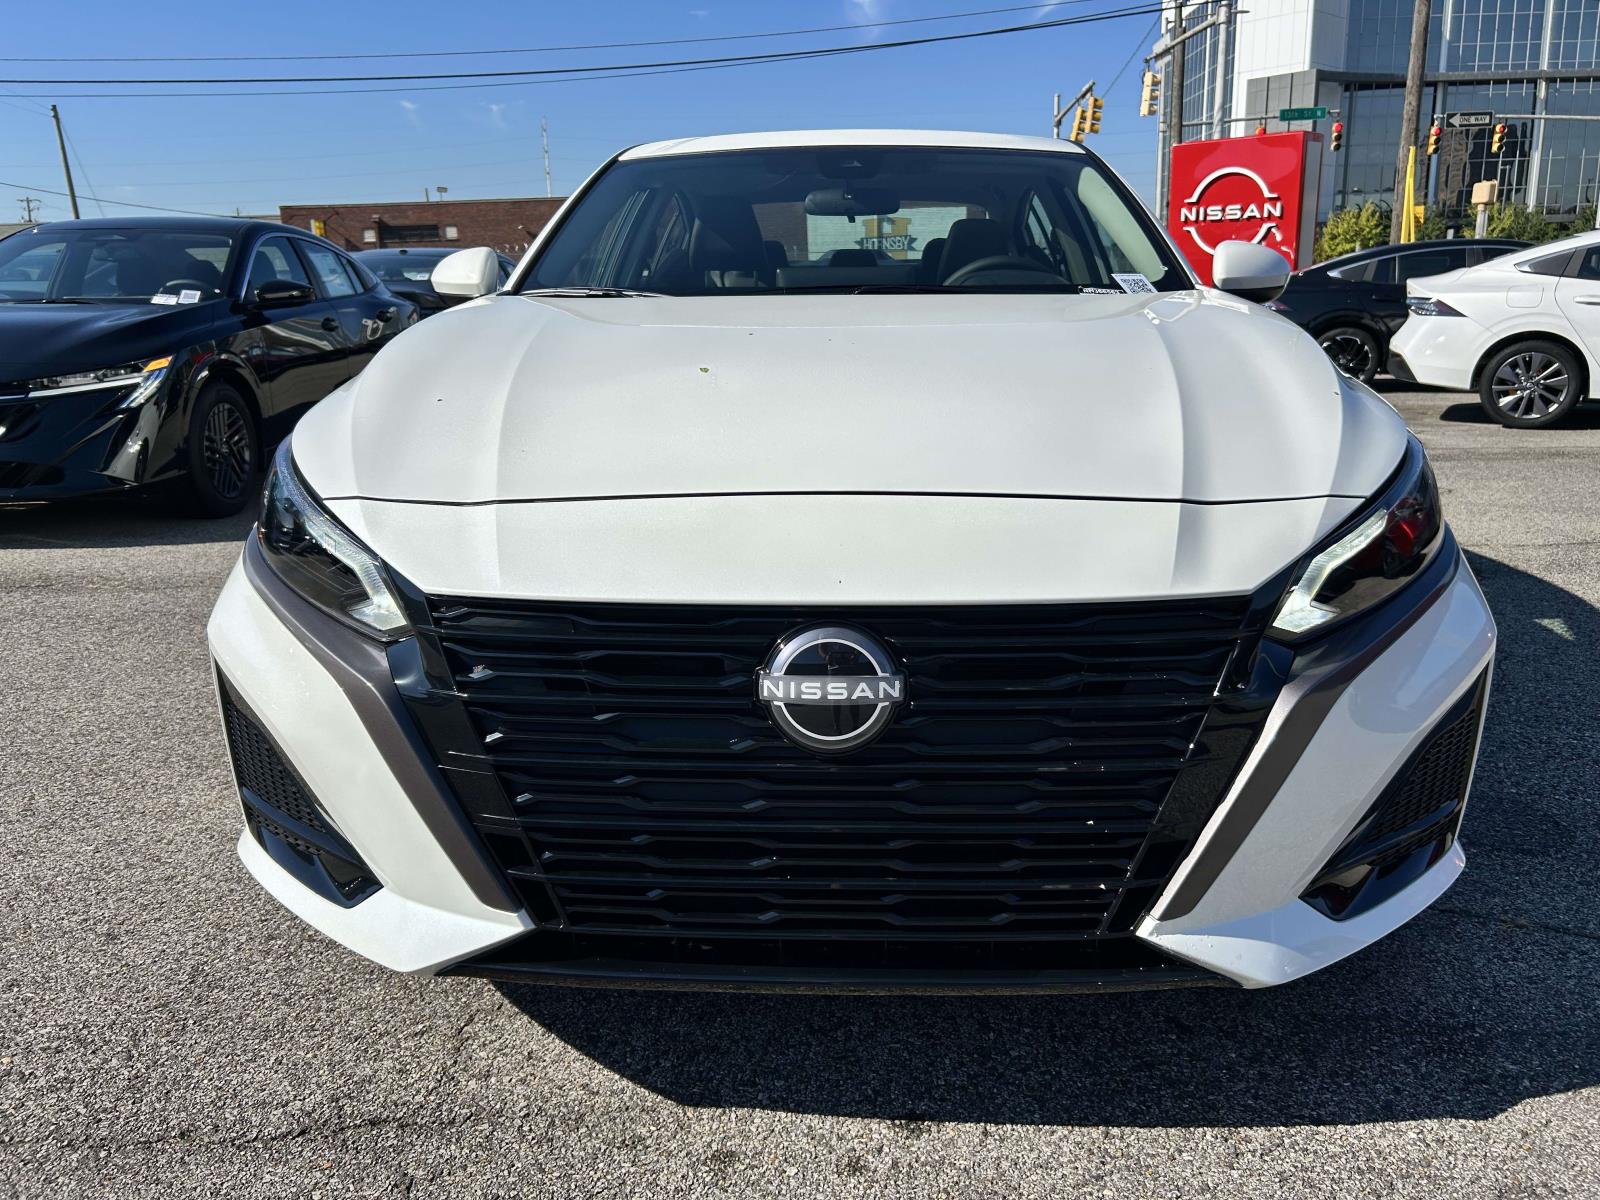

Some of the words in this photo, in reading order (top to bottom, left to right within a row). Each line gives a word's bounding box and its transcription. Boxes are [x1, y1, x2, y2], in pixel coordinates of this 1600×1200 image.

[1460, 115, 1472, 123] ONE
[1474, 115, 1487, 123] WAY
[1180, 201, 1282, 222] NISSAN
[763, 679, 901, 700] NISSAN
